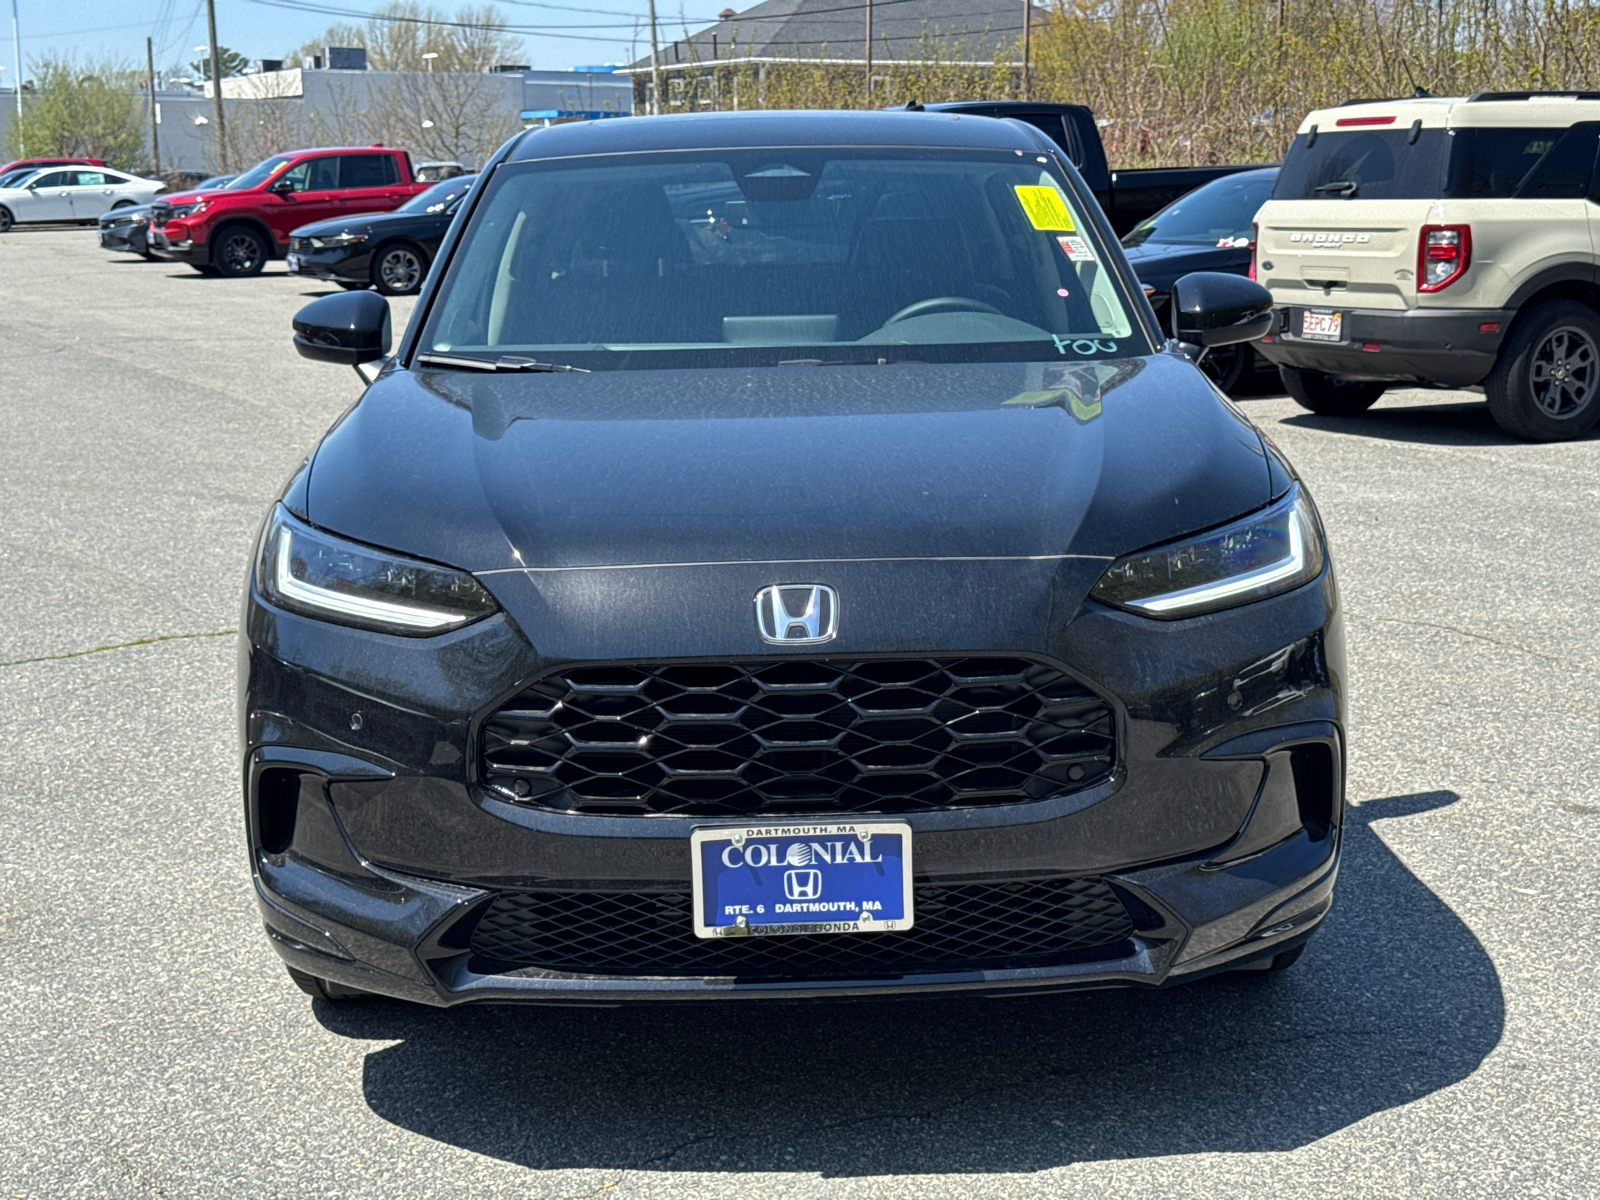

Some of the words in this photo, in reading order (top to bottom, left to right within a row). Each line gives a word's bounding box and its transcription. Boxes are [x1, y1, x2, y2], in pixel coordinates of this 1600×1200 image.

[1290, 233, 1370, 243] BRONCO
[746, 826, 833, 837] DARTMOUTH,
[837, 825, 856, 834] MA
[721, 840, 882, 868] COLONIAL
[724, 905, 754, 915] RTE.
[756, 904, 765, 914] 6
[775, 901, 860, 913] DARTMOUTH,
[862, 901, 882, 911] MA
